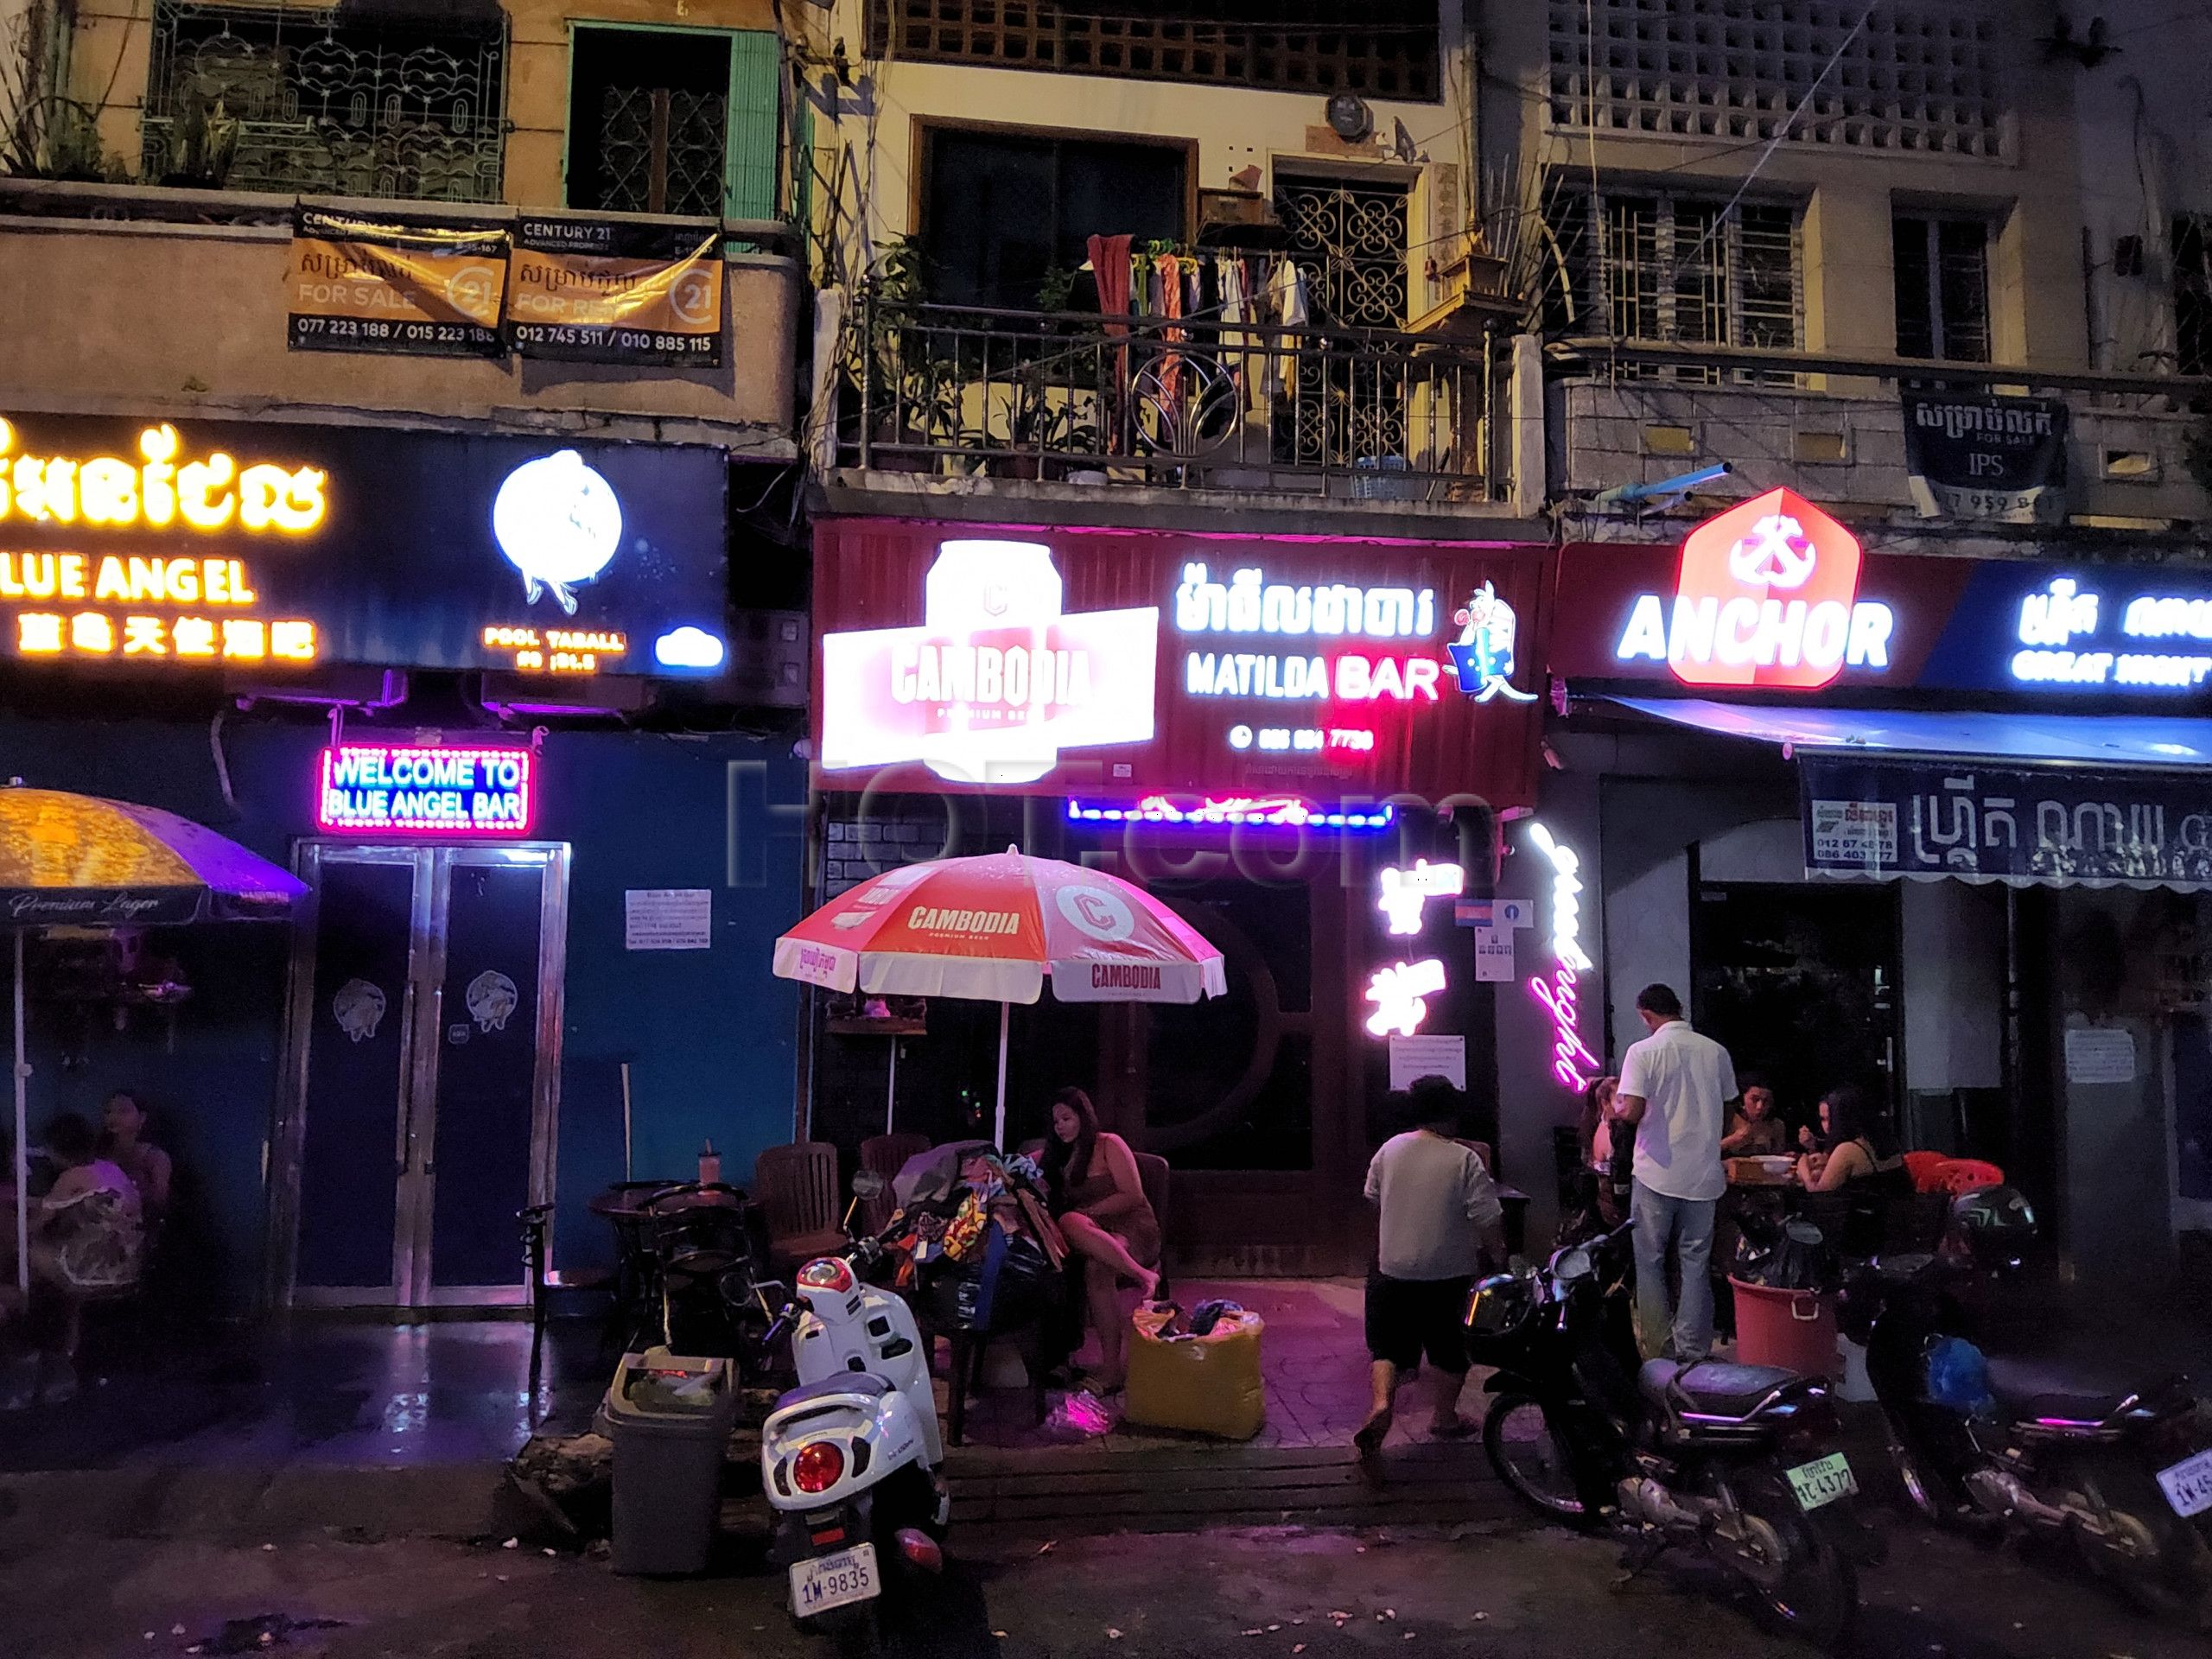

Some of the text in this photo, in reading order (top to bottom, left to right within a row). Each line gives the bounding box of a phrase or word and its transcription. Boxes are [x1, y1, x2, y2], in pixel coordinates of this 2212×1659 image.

[524, 223, 611, 240] CENTURY 21
[298, 283, 416, 310] FOR SALE
[515, 293, 566, 314] FOR
[684, 284, 712, 310] 21
[297, 318, 325, 333] 077
[329, 321, 357, 334] 223
[362, 322, 389, 337] 188
[407, 325, 434, 340] 015
[437, 327, 464, 342] 223
[516, 326, 543, 342] 012
[549, 327, 575, 343] 745
[581, 330, 603, 346] 511
[622, 334, 650, 349] 010
[655, 336, 684, 352] 885
[690, 337, 711, 352] 115
[1976, 433, 2001, 443] FOR
[1969, 453, 2005, 476] IPS
[95, 556, 257, 604] ANGEL
[484, 626, 541, 646] POOL
[1617, 594, 1893, 667] ANCHOR
[891, 644, 1092, 707] CAMBODIA
[1186, 652, 1440, 701] MATILDA BAR
[334, 757, 520, 787] WELCOME TO
[328, 789, 520, 820] BLUE ANGEL BAR
[9, 891, 159, 919] Premium Lager
[907, 906, 1020, 936] CAMBODIA
[1091, 963, 1161, 990] CAMBODIA
[1529, 954, 1599, 1093] night
